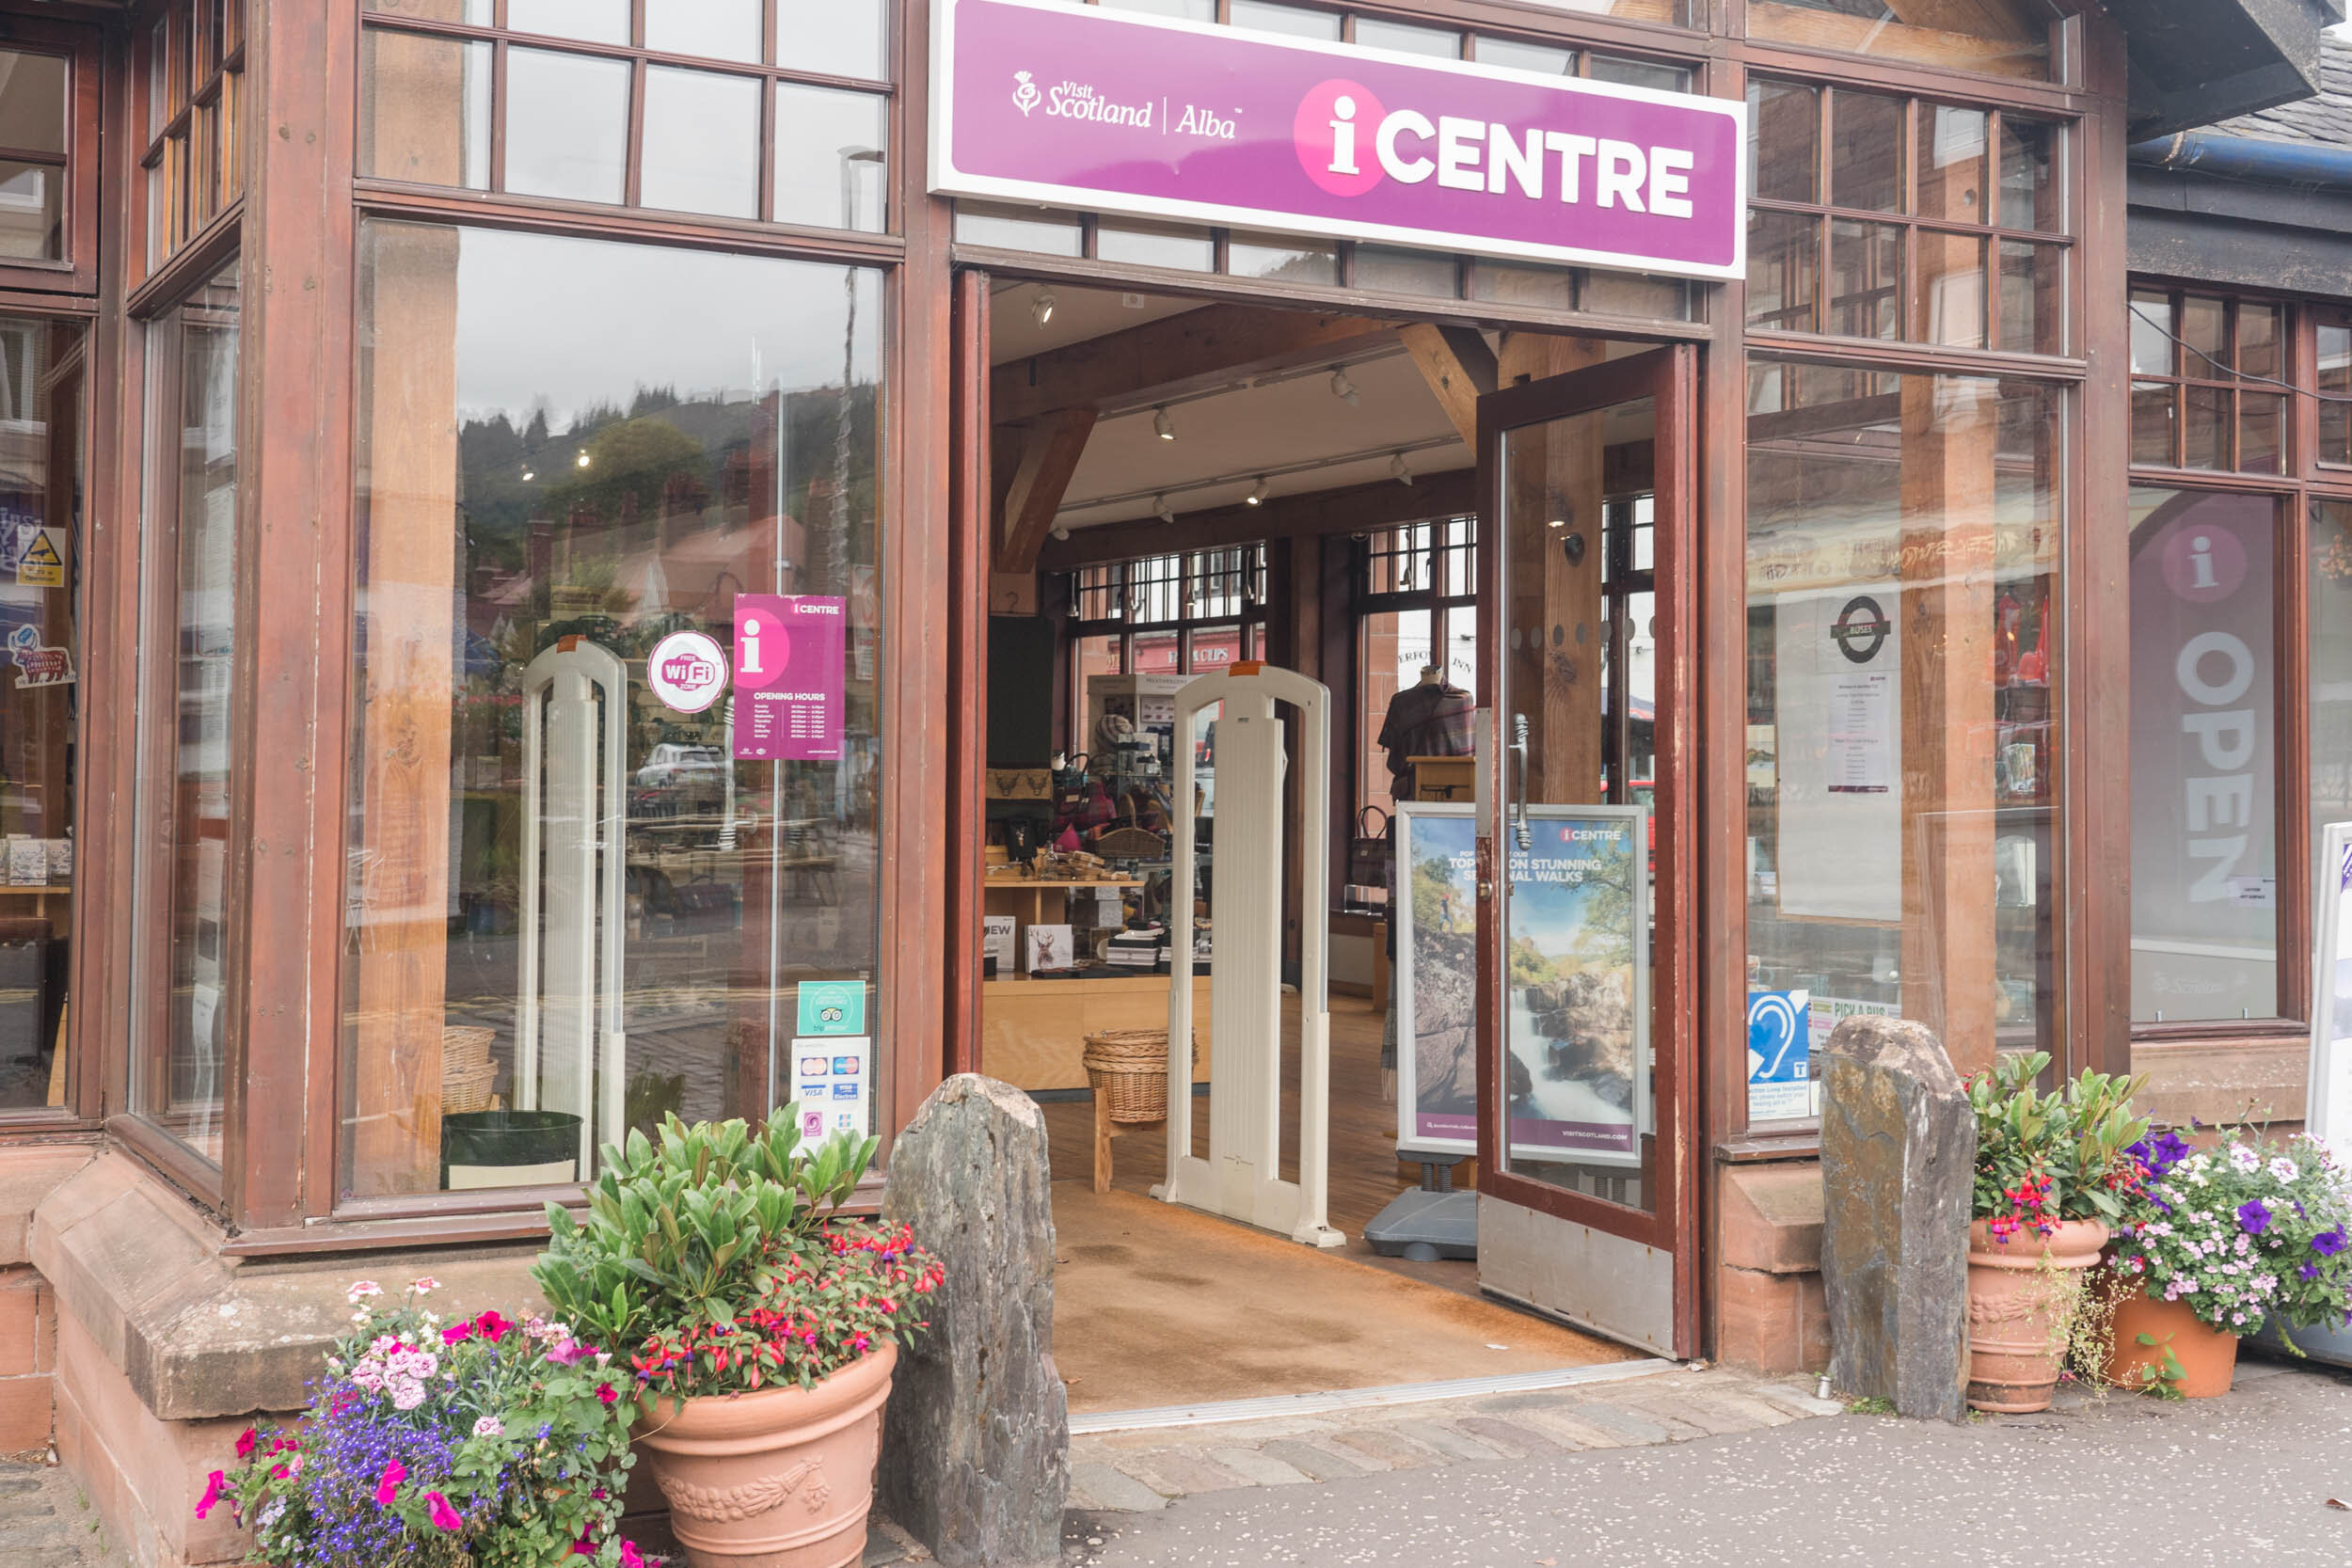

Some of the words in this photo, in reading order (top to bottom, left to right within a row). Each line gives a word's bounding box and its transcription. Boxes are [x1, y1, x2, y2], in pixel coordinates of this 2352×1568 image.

[1062, 81, 1094, 100] Visit
[1045, 86, 1153, 128] Scotland
[1174, 104, 1236, 139] Alba
[1850, 624, 1872, 635] BUSES
[1452, 657, 1473, 673] INN
[754, 691, 793, 701] OPENING
[794, 692, 826, 702] HOURS
[2175, 631, 2256, 904] OPEN
[1449, 858, 1475, 869] TOP
[1531, 859, 1602, 871] STUNNING
[1535, 870, 1583, 882] WALKS
[1835, 1002, 1856, 1017] PICK
[804, 1088, 823, 1098] VISA
